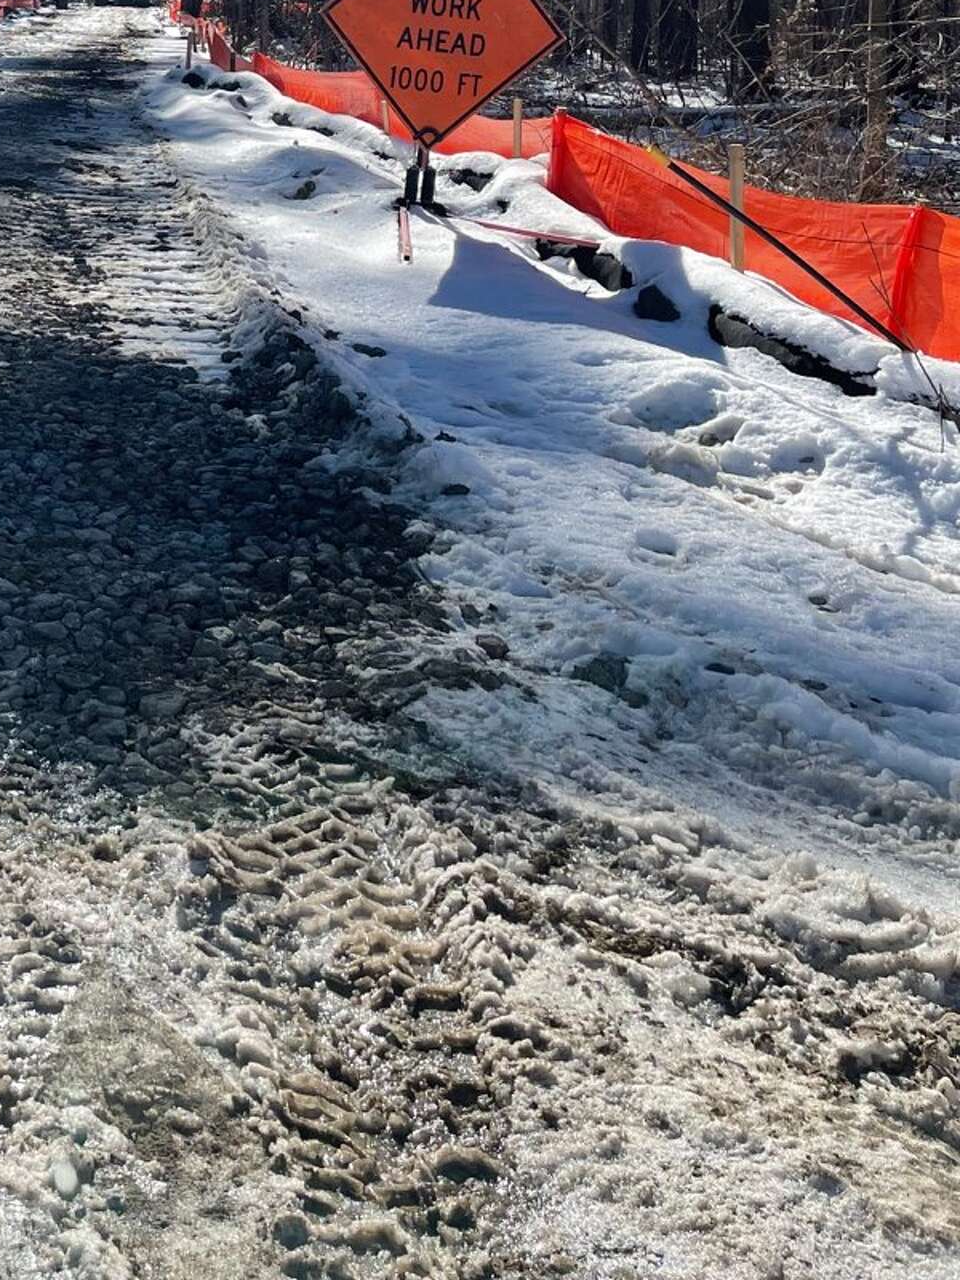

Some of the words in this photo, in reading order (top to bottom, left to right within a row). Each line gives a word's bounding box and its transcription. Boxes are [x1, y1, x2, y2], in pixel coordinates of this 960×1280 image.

[397, 26, 486, 57] AHEAD
[390, 65, 444, 94] 1000
[457, 73, 483, 97] FT
